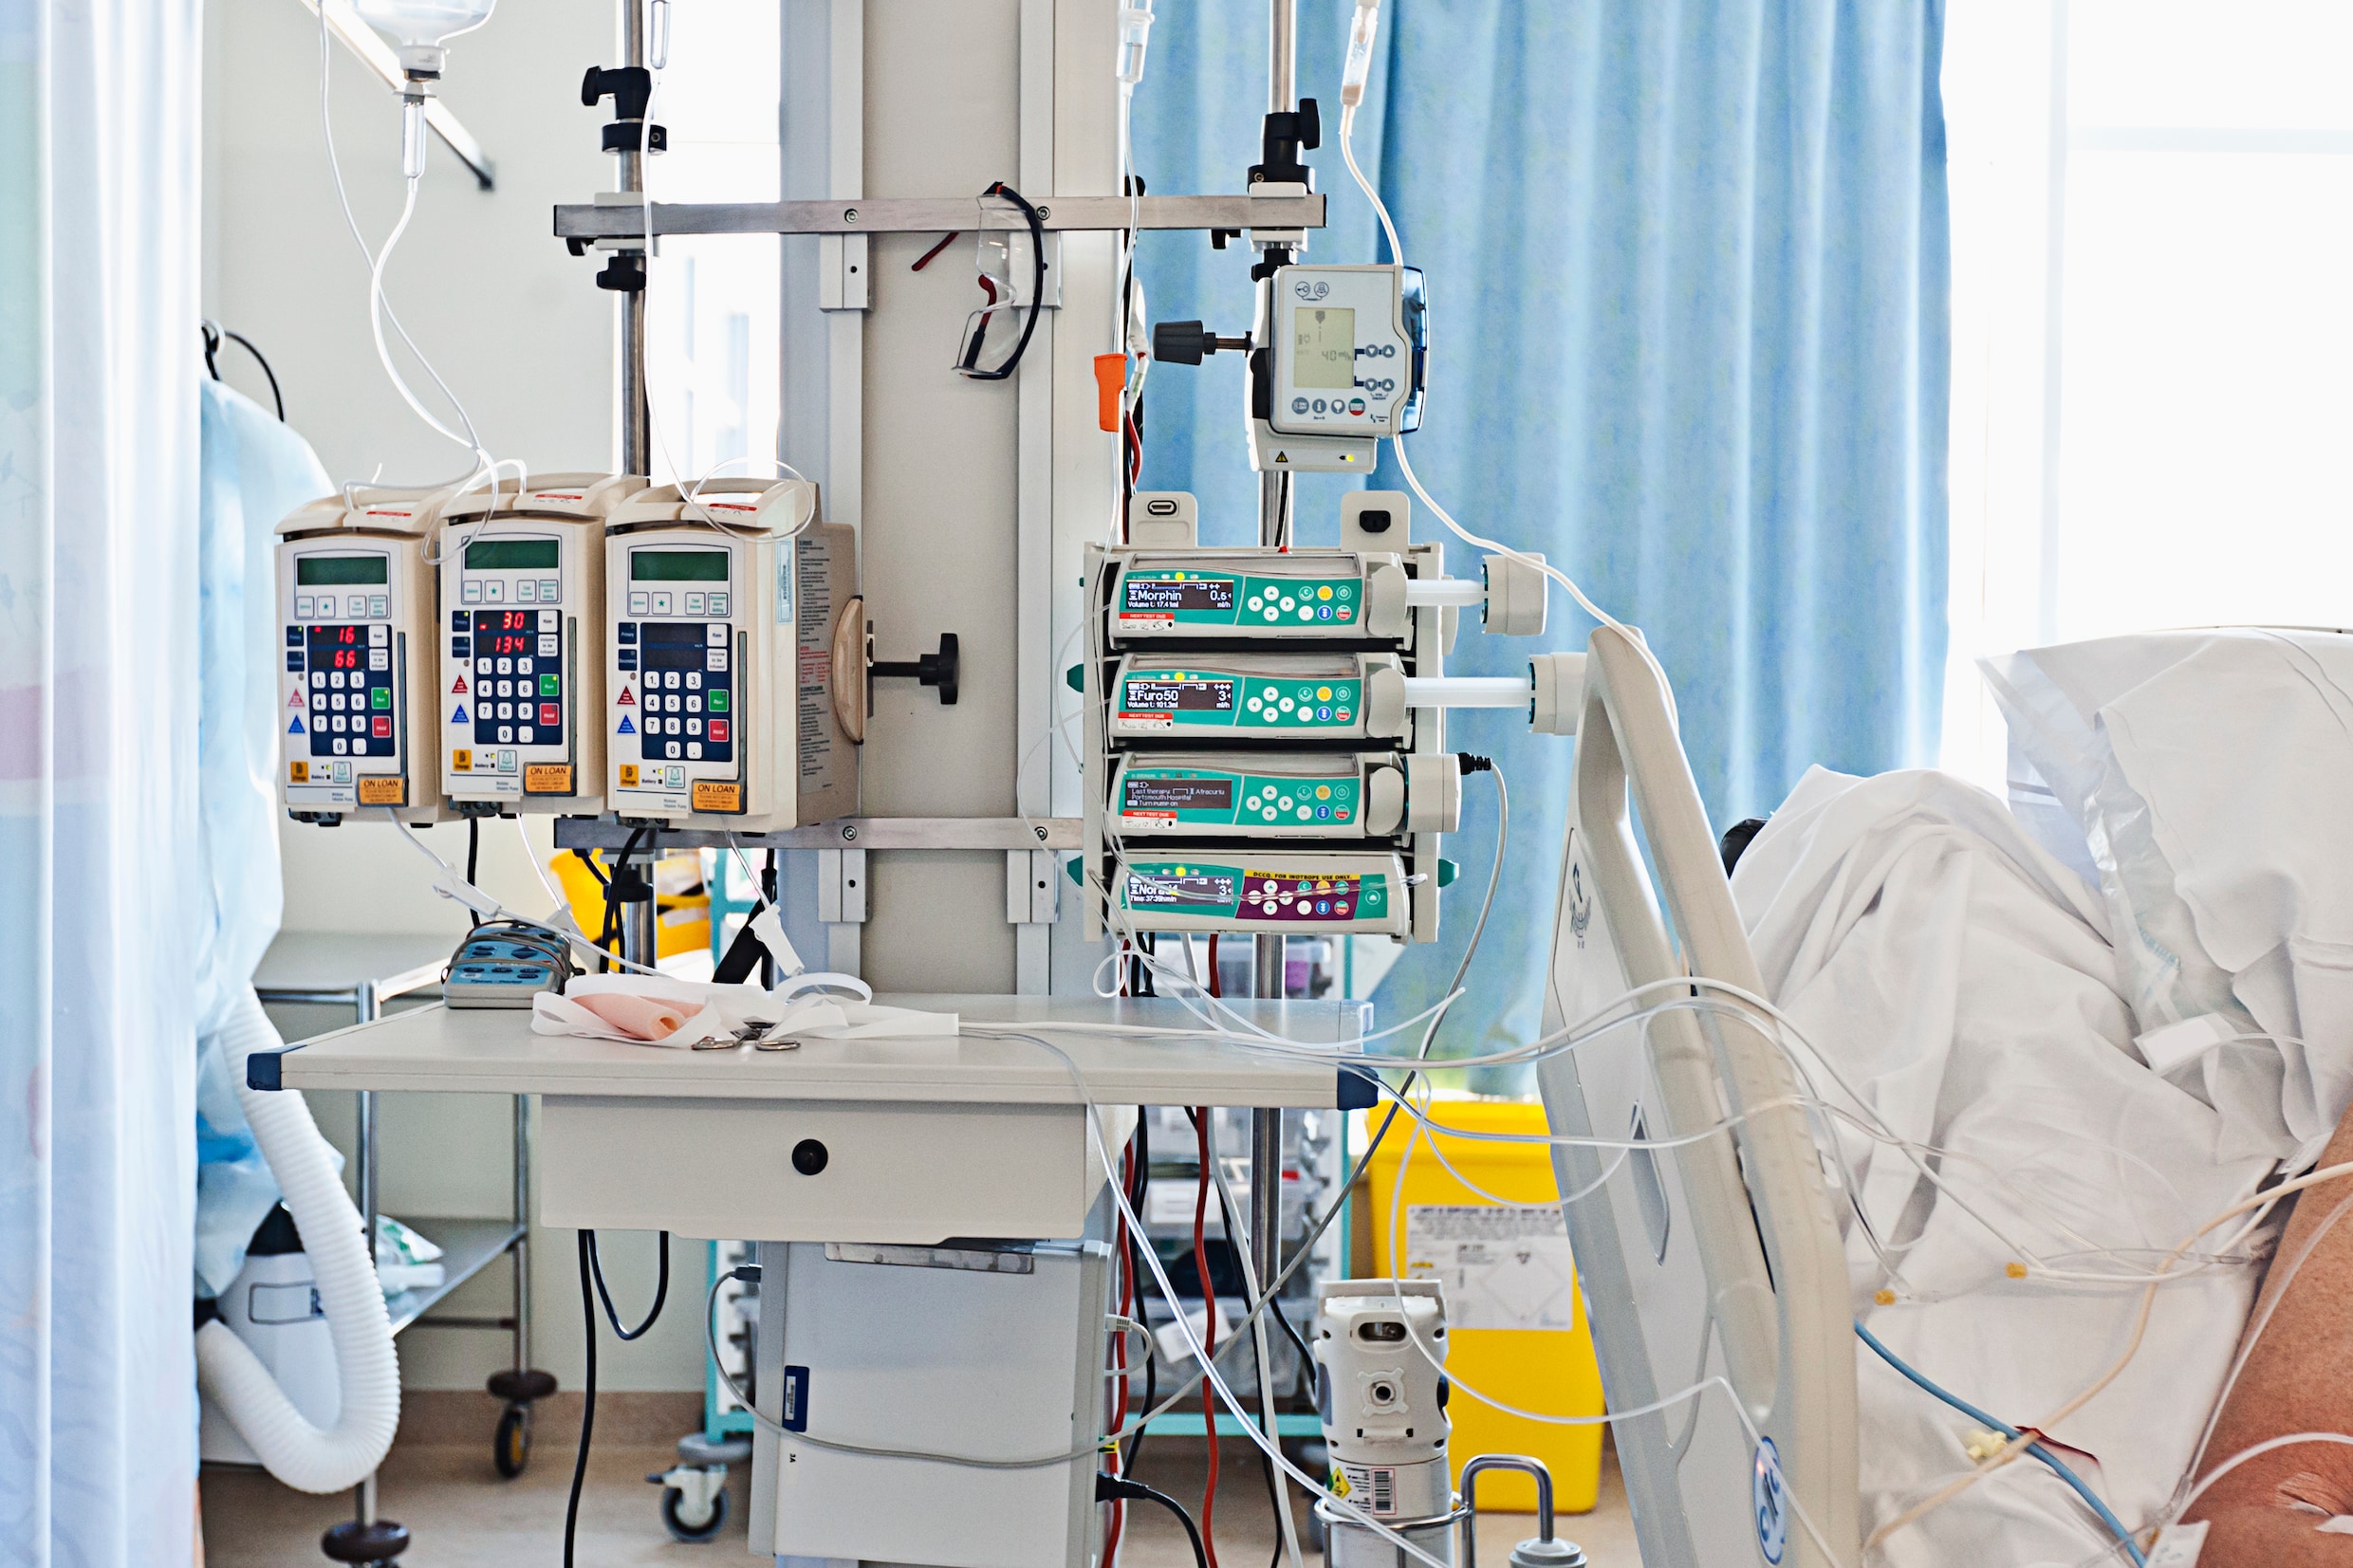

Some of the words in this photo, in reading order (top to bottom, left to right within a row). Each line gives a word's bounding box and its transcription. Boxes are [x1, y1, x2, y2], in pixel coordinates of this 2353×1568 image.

[1139, 590, 1182, 601] Morphin
[503, 610, 525, 630] 30
[339, 625, 355, 644] 16
[494, 636, 525, 655] 134
[334, 650, 356, 668] 66
[502, 662, 507, 671] 2
[355, 675, 360, 684] 3
[692, 676, 695, 685] 3
[1138, 691, 1178, 701] Furo50
[1218, 691, 1227, 701] 3
[671, 699, 675, 708] 5
[503, 707, 507, 715] 8
[670, 722, 675, 730] 8
[671, 746, 676, 754] 0
[530, 766, 542, 775] ON
[545, 766, 566, 775] LOAN
[363, 779, 375, 787] ON
[378, 779, 398, 787] LOAN
[1219, 885, 1227, 895] 3
